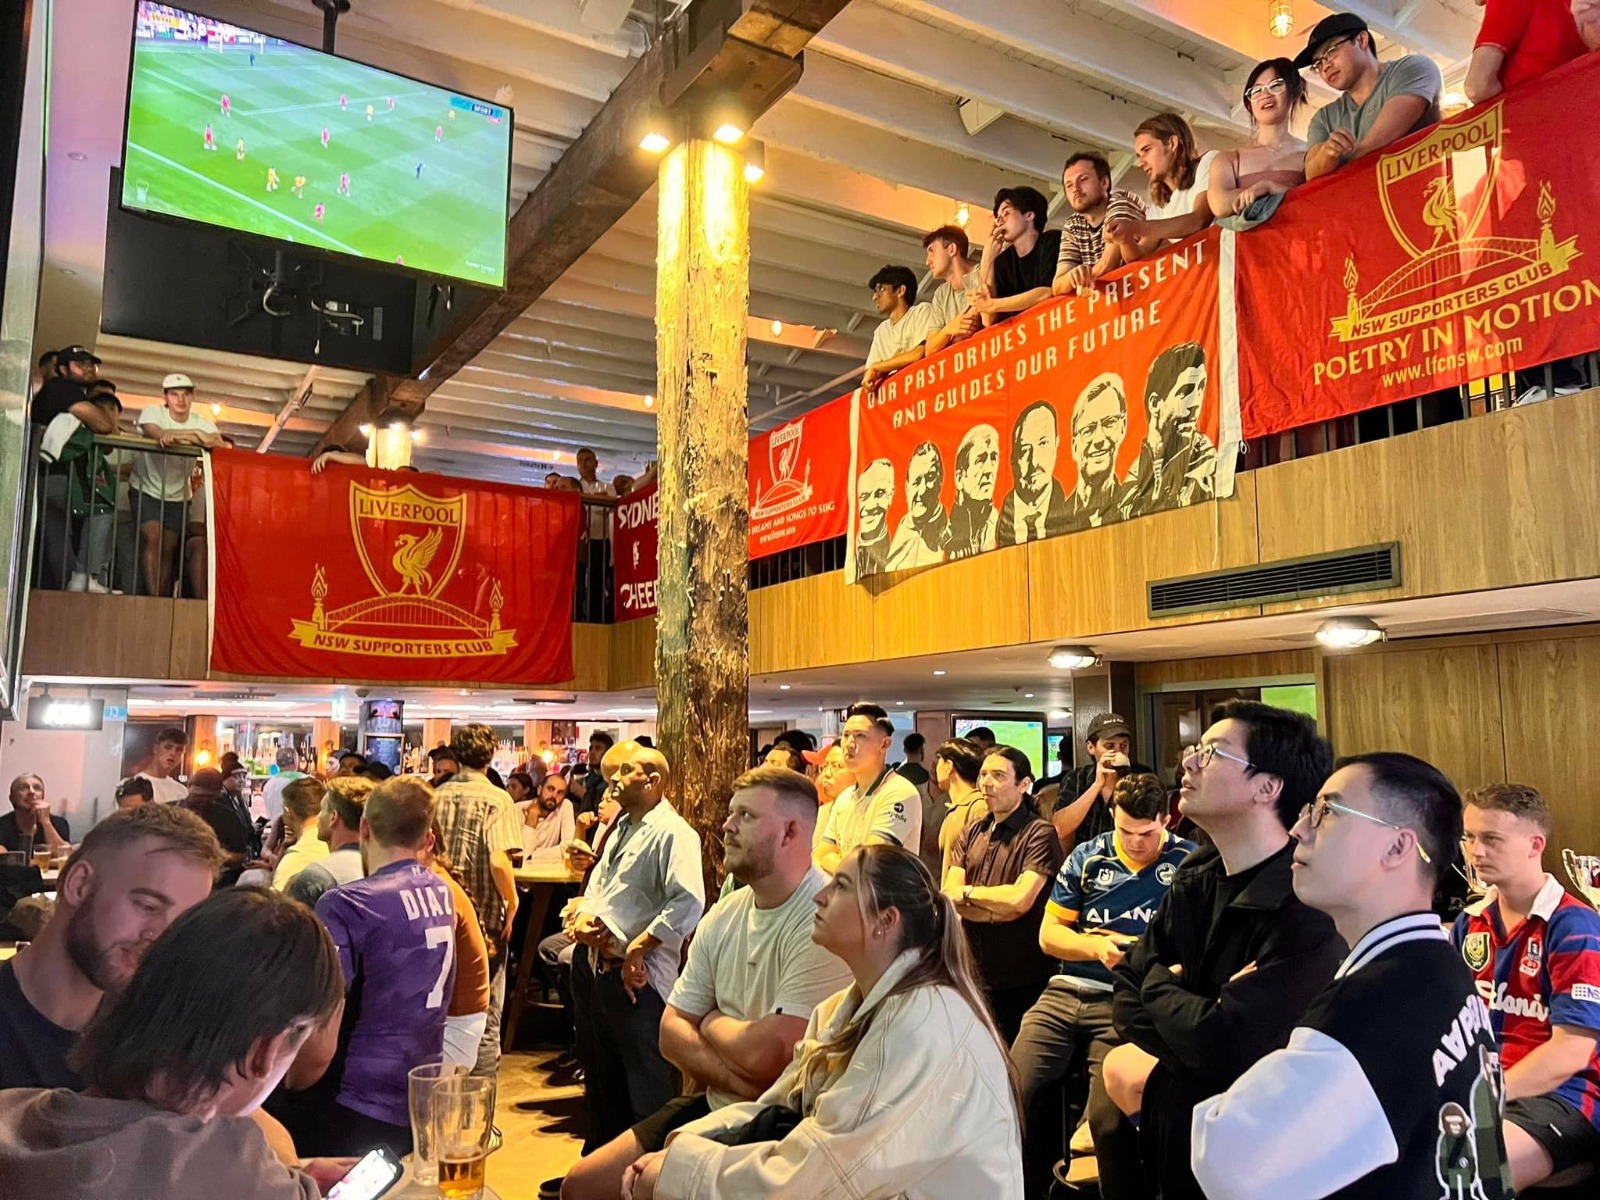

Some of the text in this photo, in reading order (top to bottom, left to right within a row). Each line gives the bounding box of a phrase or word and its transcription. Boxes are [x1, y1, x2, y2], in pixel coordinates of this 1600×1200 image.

[1385, 122, 1495, 181] LIVERPOOL
[866, 239, 1207, 410] OUR PAST DRIVES THE PRESENT
[1350, 261, 1554, 338] NSW SUPPORTERS CLUB
[892, 300, 1162, 430] AND GUIDES OUR FUTURE
[1313, 332, 1413, 386] POETRY
[1421, 322, 1454, 354] IN
[1381, 336, 1523, 388] www.lfcnsw.com
[771, 427, 800, 447] LIVERPOOL
[359, 498, 459, 524] LIVERPOOL
[617, 491, 659, 530] SYDNE
[773, 516, 785, 527] AND
[786, 510, 807, 522] SONGS
[807, 505, 817, 516] TO
[313, 633, 494, 655] NSW SUPPORTERS CLUB
[400, 886, 453, 920] DIAZ
[425, 925, 453, 1009] 7
